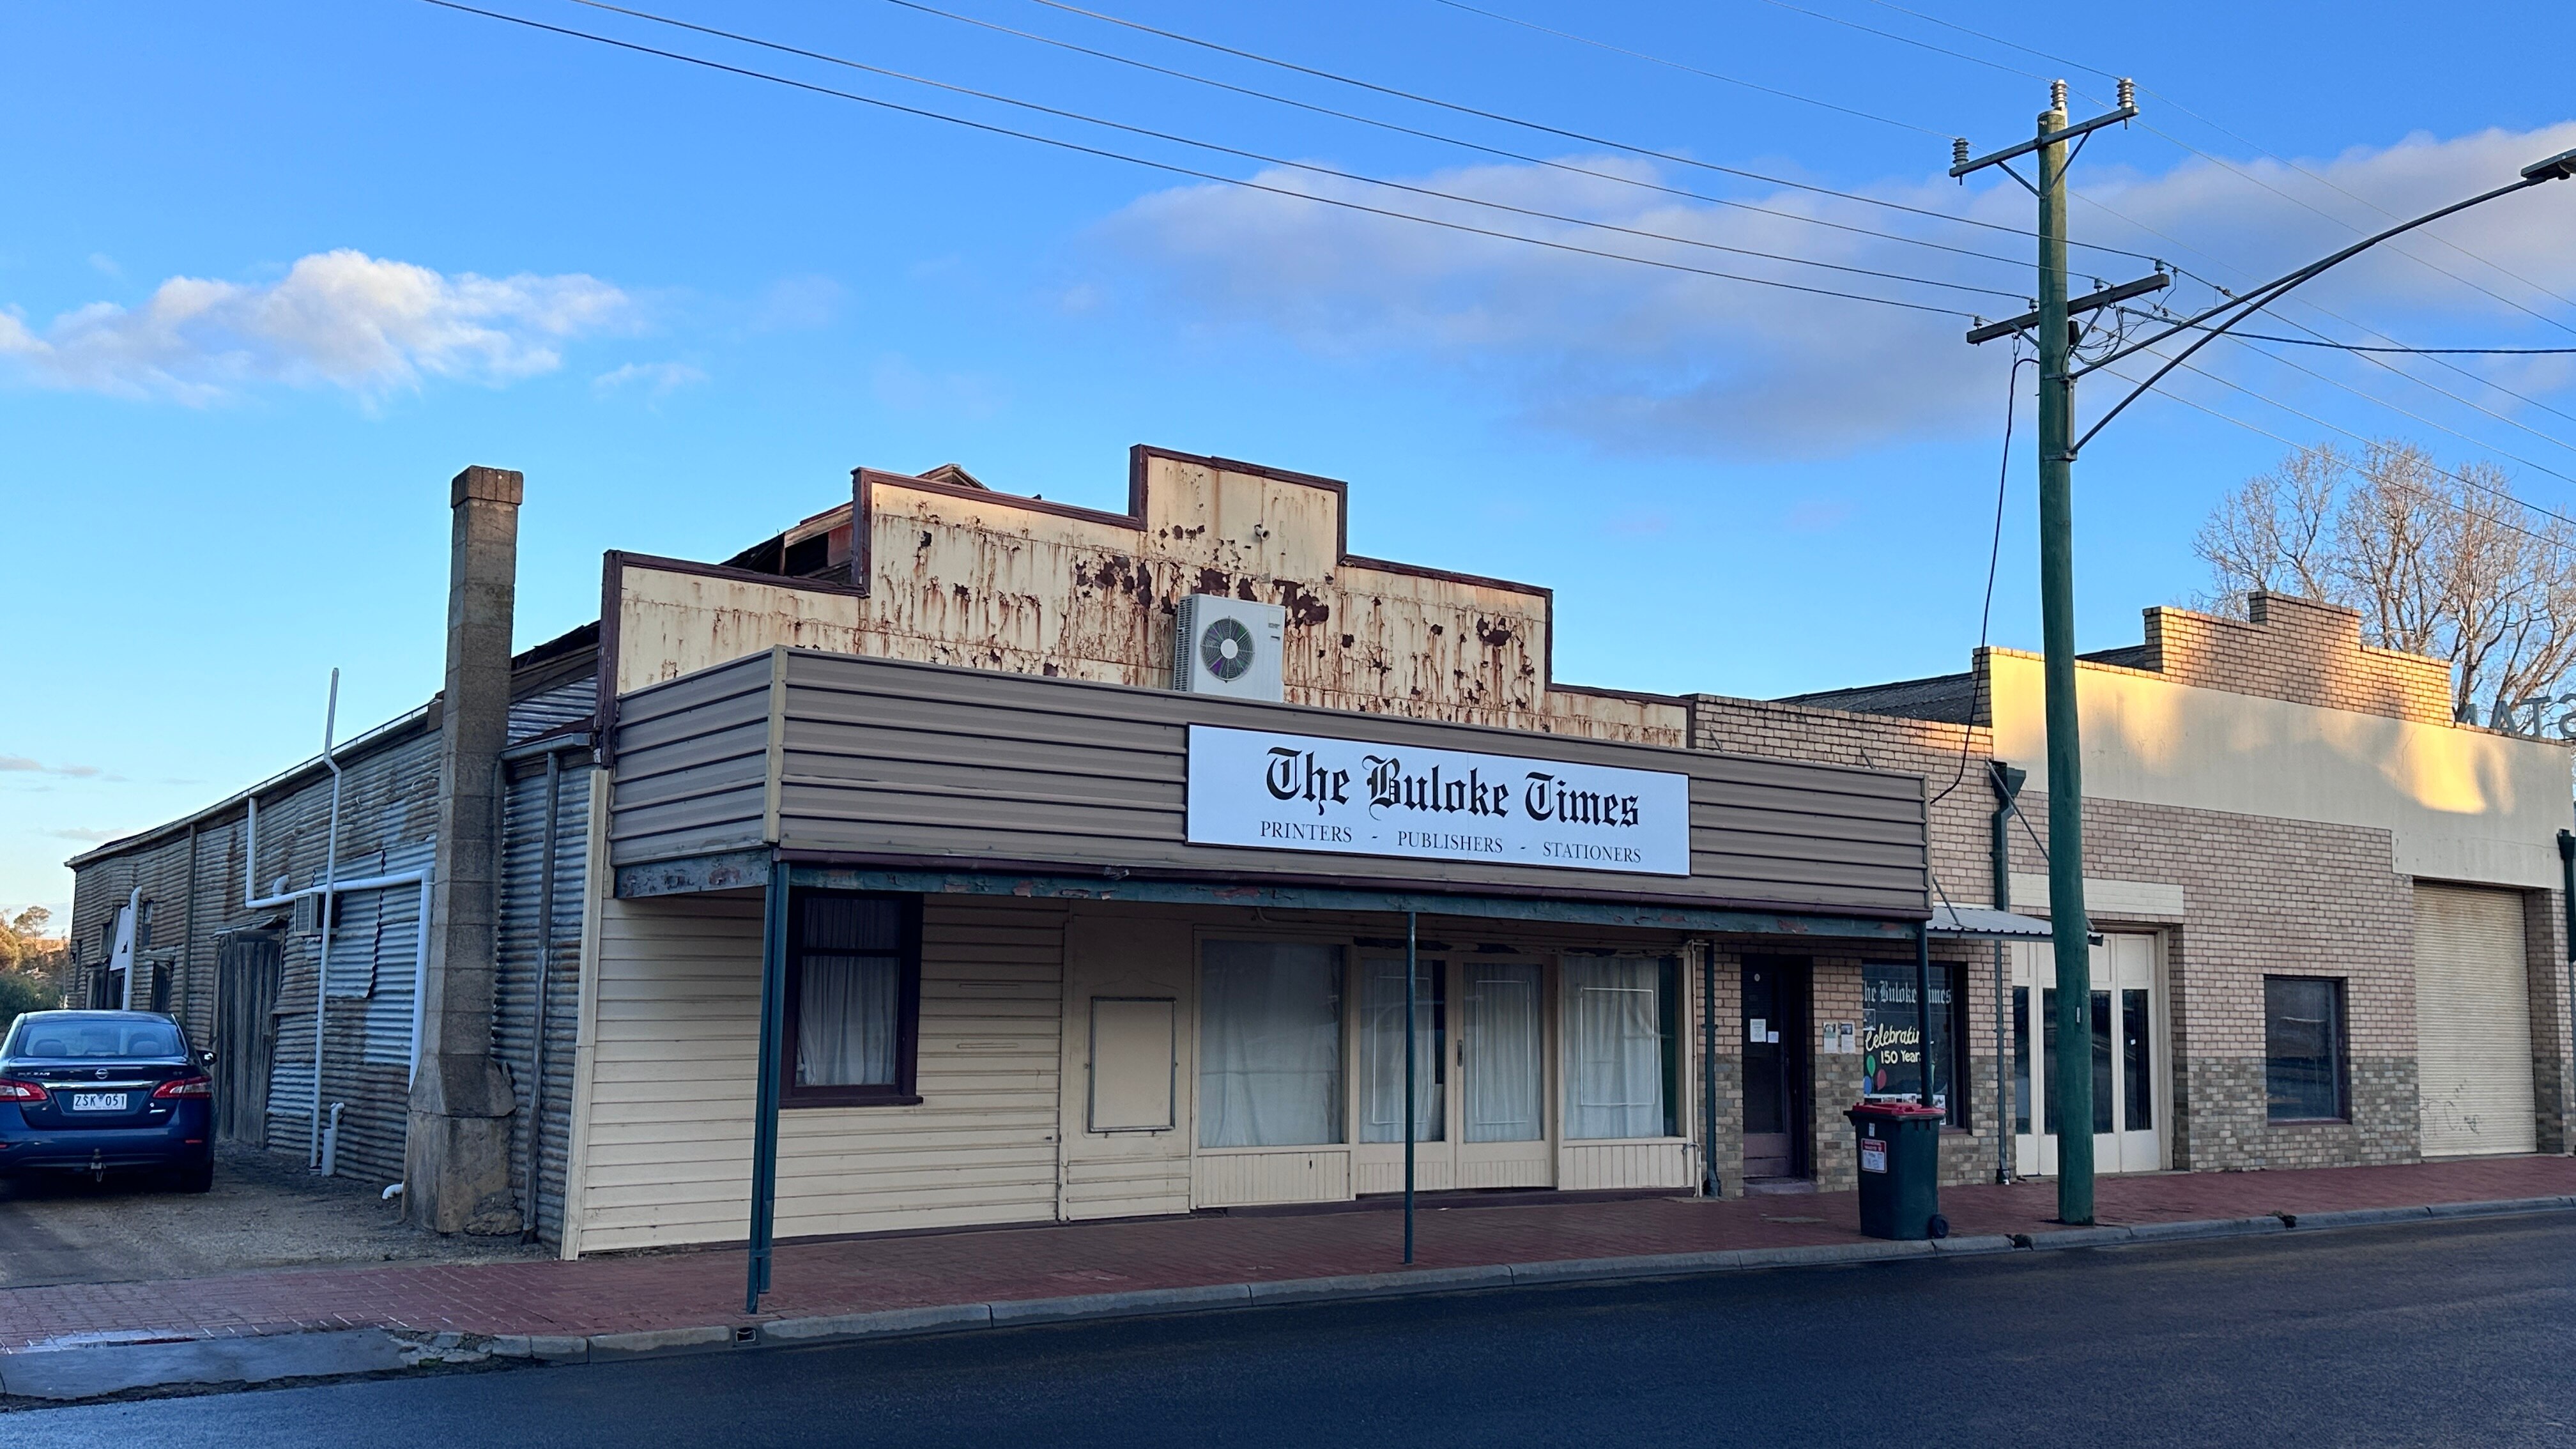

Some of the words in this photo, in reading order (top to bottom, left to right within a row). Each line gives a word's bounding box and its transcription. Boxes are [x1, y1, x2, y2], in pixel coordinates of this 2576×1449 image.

[1266, 746, 1351, 816] The
[1361, 755, 1510, 821] Buloke
[1525, 771, 1639, 828] Times
[1261, 820, 1352, 843] PRINTERS
[1398, 831, 1503, 854] PUBLISHERS
[1543, 841, 1641, 863] STATIONERS
[1863, 980, 1877, 1004] he
[1879, 980, 1917, 1008] Buloke
[1928, 984, 1952, 1004] imes
[1865, 1023, 1935, 1052] Celebrati
[1880, 1050, 1899, 1064] 150
[75, 1095, 96, 1107] ZSK
[105, 1095, 125, 1107] 051
